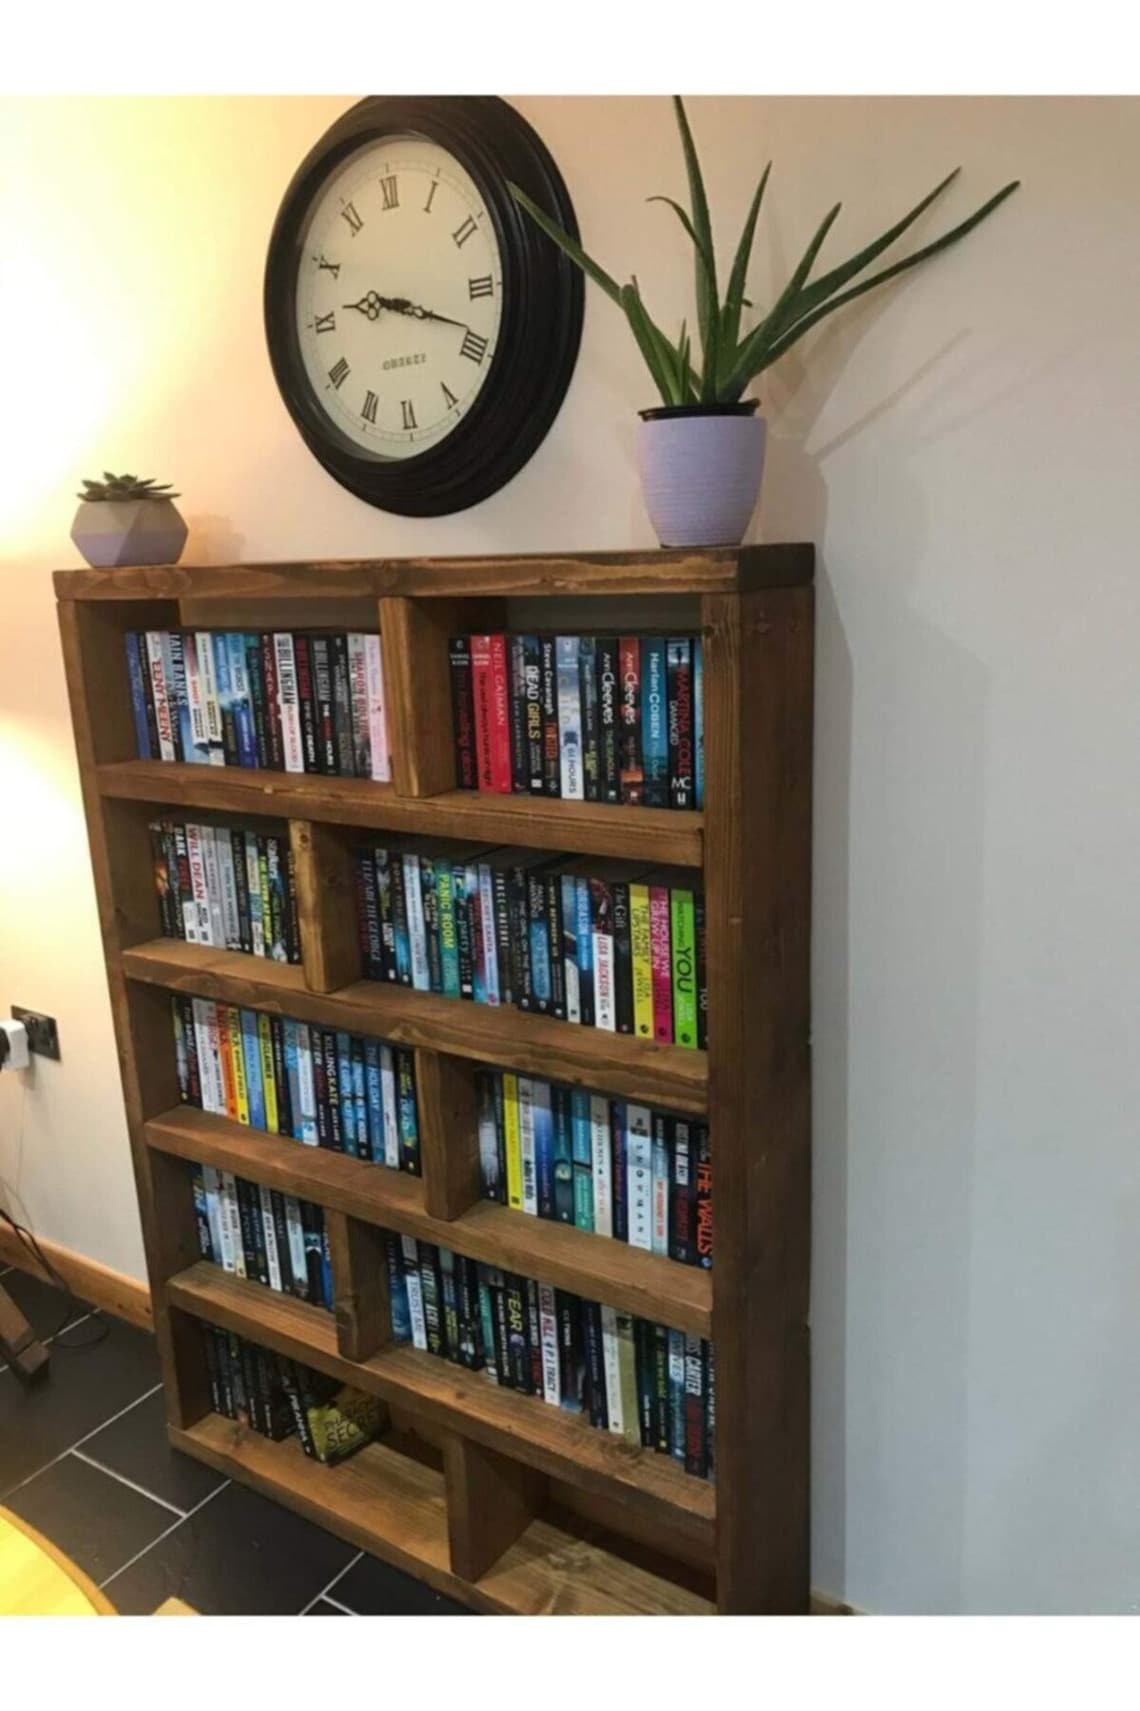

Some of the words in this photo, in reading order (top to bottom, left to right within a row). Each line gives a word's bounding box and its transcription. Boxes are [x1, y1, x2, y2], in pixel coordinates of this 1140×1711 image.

[452, 214, 478, 249] II
[468, 274, 494, 301] III
[169, 633, 183, 660] IAIN
[492, 642, 504, 672] NEIL
[543, 643, 552, 669] Steve
[602, 652, 612, 674] Ann
[625, 652, 634, 674] Ann
[151, 660, 165, 695] EENY
[173, 664, 188, 707] BANKS
[264, 647, 274, 696] SNAP
[278, 648, 297, 705] BILLINGHAM
[354, 651, 368, 694] SHARON
[525, 664, 541, 701] DEAD
[650, 651, 661, 693] Harlan
[494, 675, 505, 727] GAIMAN
[544, 670, 553, 715] Cavanagh
[601, 671, 615, 725] Cleeves
[624, 671, 638, 725] Cleeves
[677, 667, 692, 734] MARTINA
[157, 698, 172, 743] MEENY
[527, 702, 541, 739] GIRLS
[650, 692, 661, 739] COBEN
[669, 700, 680, 746] DAMAGED
[678, 737, 692, 776] COLE
[568, 758, 578, 795] HOURS
[188, 826, 200, 858] WILL
[192, 862, 205, 900] DEAN
[438, 873, 452, 911] PANIC
[441, 913, 455, 949] ROOM
[614, 903, 628, 929] Gift
[632, 907, 642, 957] UPSTAIRS
[677, 902, 687, 948] WATCHING
[596, 936, 609, 956] LISA
[641, 925, 651, 966] FAMILY
[659, 918, 670, 957] HOUSE
[598, 957, 611, 999] JACKSON
[676, 947, 693, 994] YOU
[700, 987, 709, 1011] YOU
[312, 1031, 323, 1066] AFTER
[324, 1034, 337, 1077] KILLING
[328, 1077, 339, 1106] KATE
[367, 1065, 381, 1111] HOLIDAY
[697, 1162, 714, 1193] THE
[697, 1198, 714, 1256] WALLS
[410, 1280, 422, 1315] TRUST
[507, 1288, 523, 1333] FEAR
[413, 1315, 424, 1332] ME
[685, 1355, 703, 1396] CARTER
